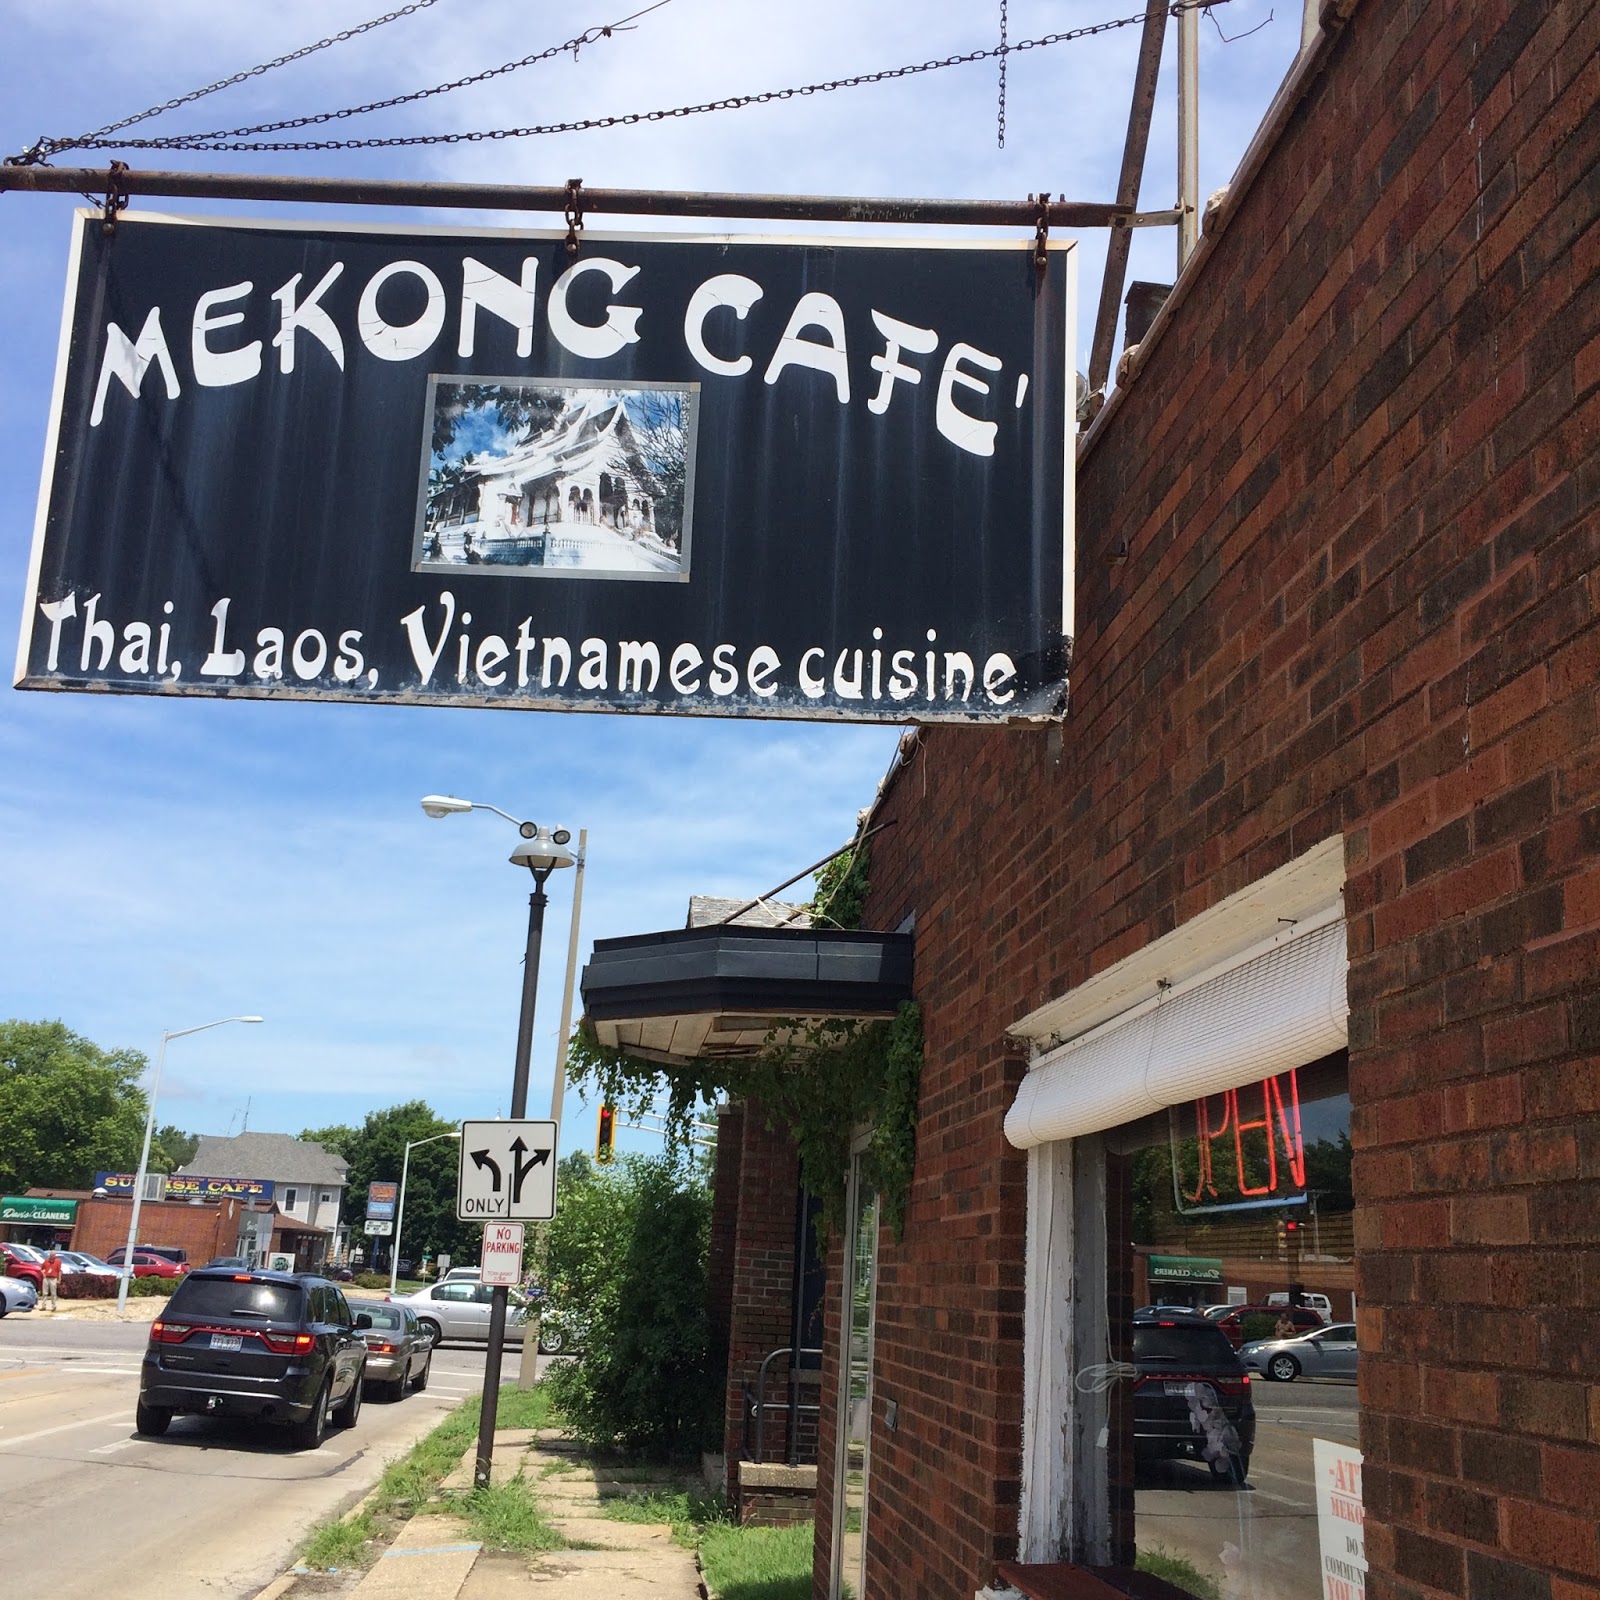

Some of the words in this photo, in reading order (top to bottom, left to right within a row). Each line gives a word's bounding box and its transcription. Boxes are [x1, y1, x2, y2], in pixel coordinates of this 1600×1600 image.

[90, 256, 643, 427] MEKONG
[40, 591, 183, 682] Thai,
[200, 597, 379, 689] Laos,
[401, 591, 781, 698] Vietnamese
[799, 627, 1017, 705] cuisine
[104, 1177, 200, 1190] SUISE
[208, 1182, 263, 1194] CAFE
[465, 1198, 505, 1213] ONLY
[32, 1211, 71, 1220] CLEANERS
[496, 1228, 512, 1240] NO
[486, 1241, 520, 1254] PARKING
[1330, 1497, 1366, 1526] MEKO
[1345, 1536, 1359, 1557] DO
